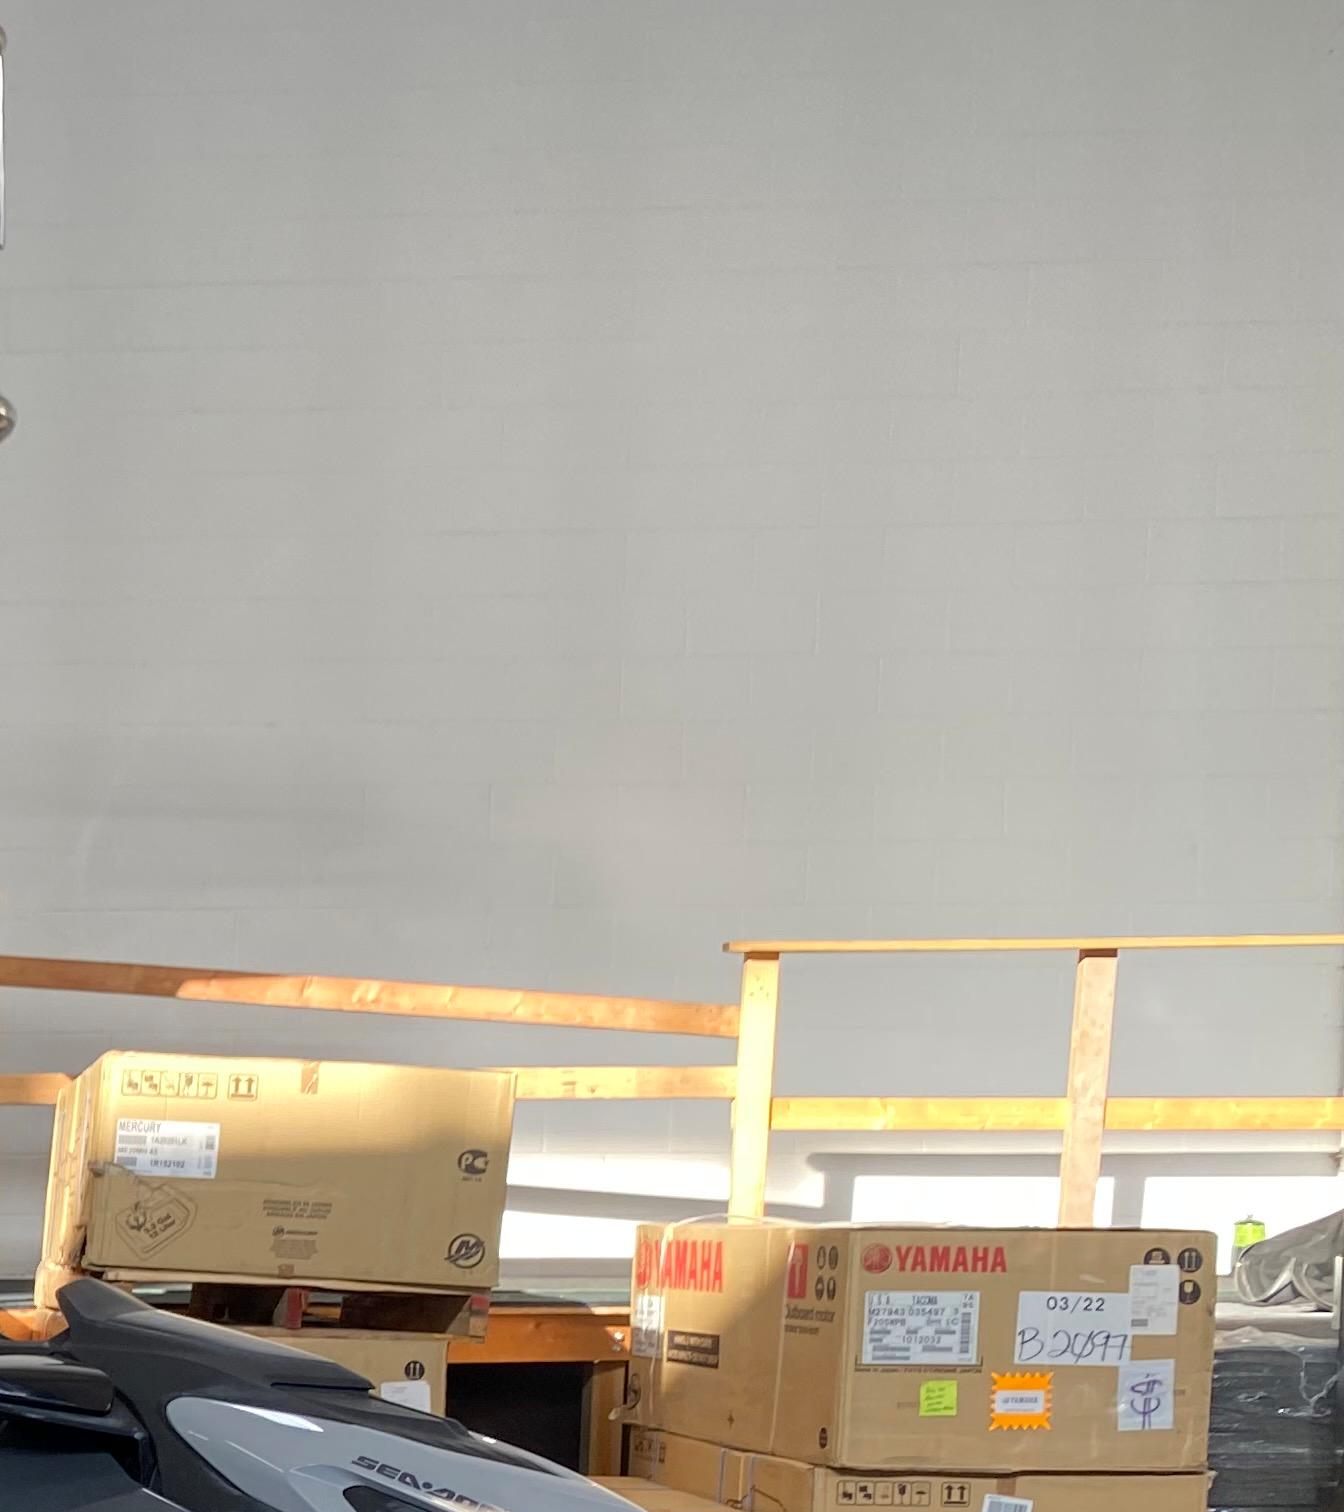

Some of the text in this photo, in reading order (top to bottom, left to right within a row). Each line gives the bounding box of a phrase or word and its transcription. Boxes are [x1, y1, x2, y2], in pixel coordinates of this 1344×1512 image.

[119, 1120, 162, 1133] MERCURY
[895, 1245, 1008, 1274] YAMAHA
[1046, 1296, 1106, 1314] 03/22
